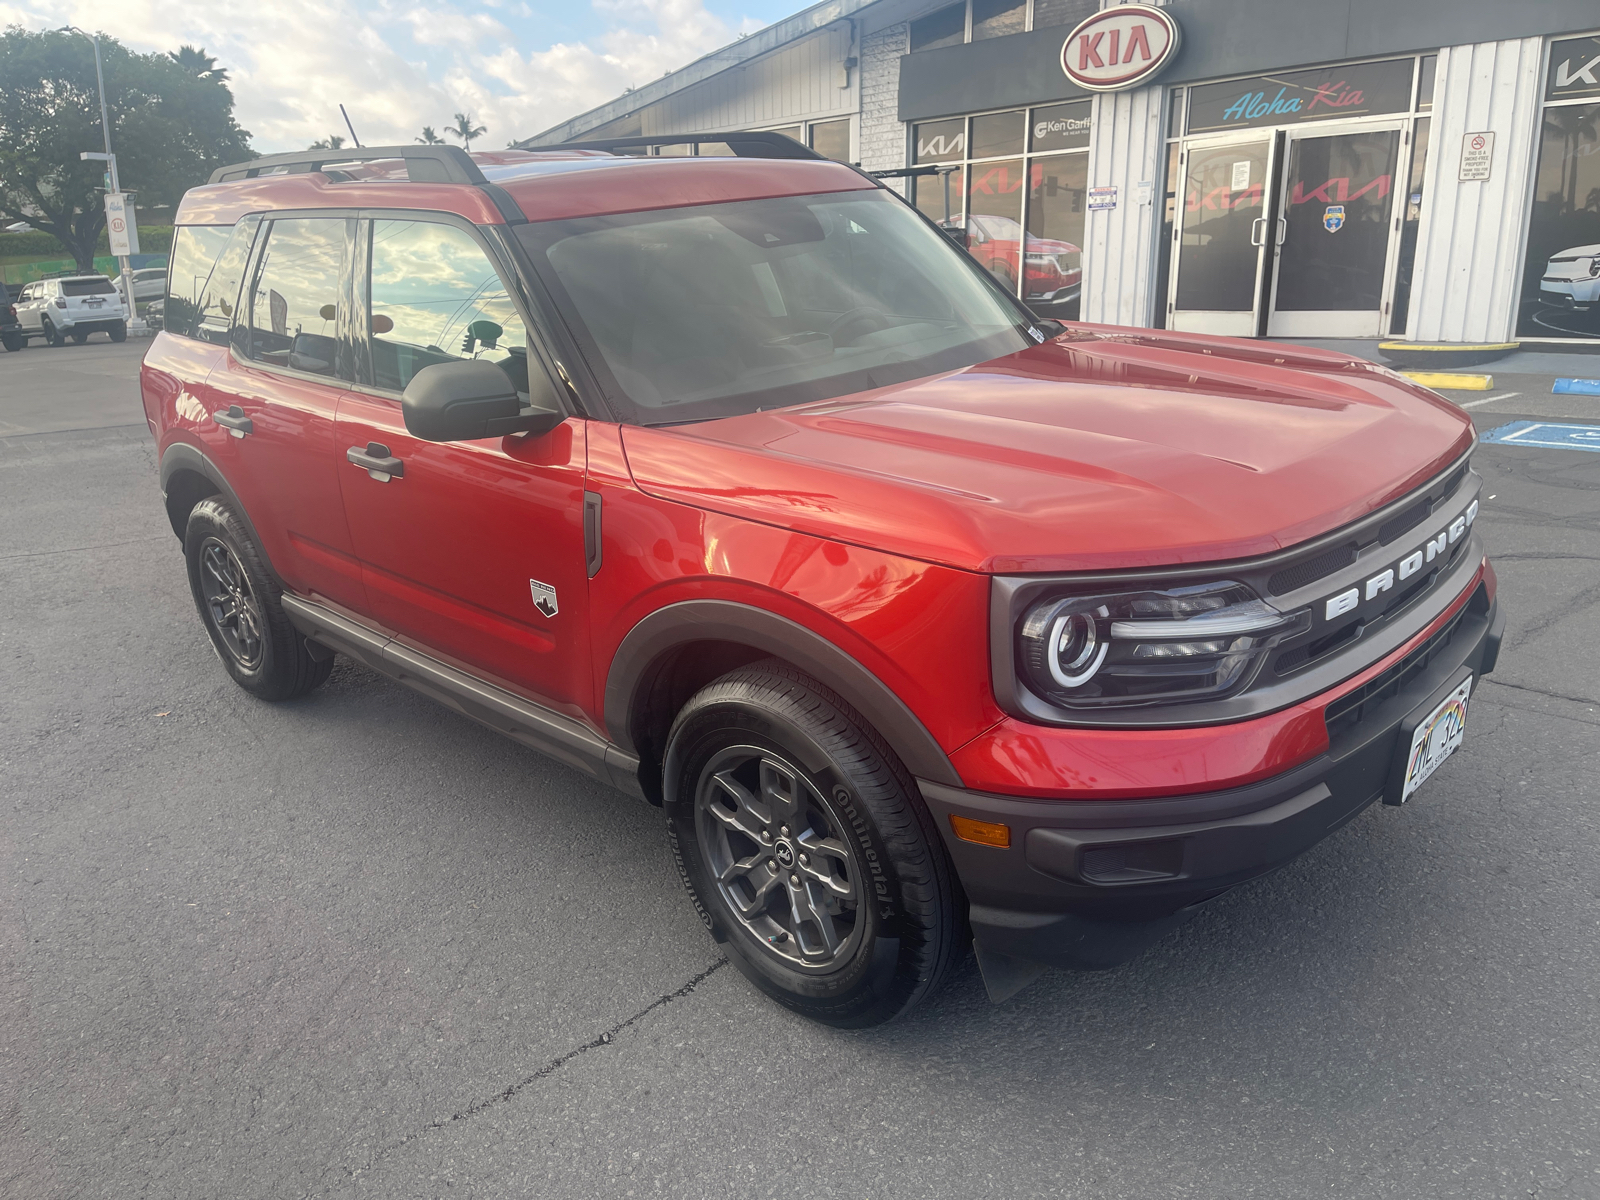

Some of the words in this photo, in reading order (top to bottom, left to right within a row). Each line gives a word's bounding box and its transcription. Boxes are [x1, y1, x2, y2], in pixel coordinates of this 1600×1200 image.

[1079, 25, 1151, 70] KIA
[1223, 87, 1302, 120] Aloha
[1307, 81, 1365, 110] Kia
[1047, 121, 1066, 132] Ken
[1067, 117, 1091, 130] Garff
[918, 133, 964, 156] KIA
[956, 163, 1043, 197] KIA
[1291, 175, 1391, 204] KIA
[1187, 183, 1262, 212] KIA
[1325, 499, 1479, 621] BRONCO
[1440, 696, 1467, 748] 322
[1420, 762, 1434, 780] ALOHA
[1434, 746, 1449, 766] STATE
[832, 784, 893, 903] Continental
